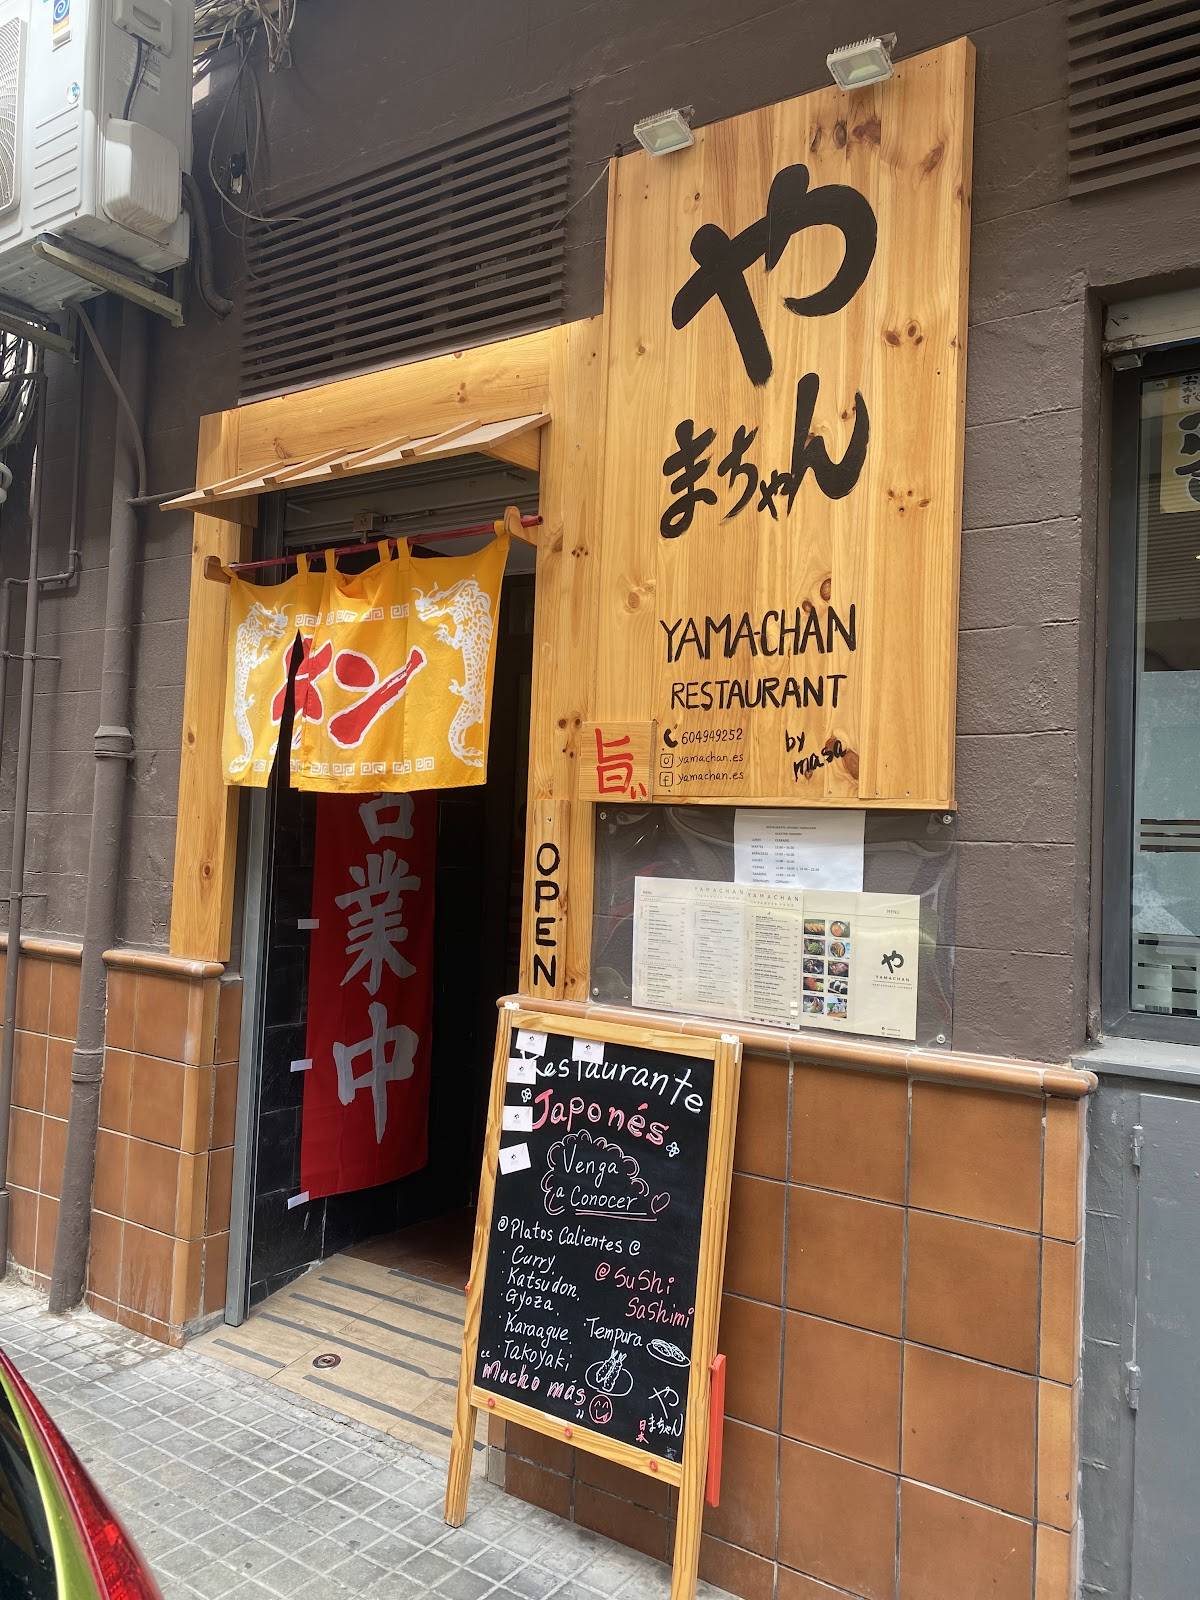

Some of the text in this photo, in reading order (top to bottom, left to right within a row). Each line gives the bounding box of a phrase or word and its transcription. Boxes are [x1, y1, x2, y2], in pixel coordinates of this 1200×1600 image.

[672, 164, 877, 387] や
[671, 674, 847, 710] RESTAURANT
[681, 728, 743, 744] 604949252
[785, 730, 806, 752] by
[676, 751, 744, 767] yamachan.es
[793, 740, 847, 782] masa
[676, 769, 744, 785] yamachan.es
[533, 843, 561, 988] OPEN
[532, 1088, 669, 1146] Japonés
[563, 1143, 619, 1188] Venga
[570, 1185, 637, 1211] Conocer
[558, 1225, 623, 1254] Calientes
[504, 1339, 573, 1372] Takoyaki
[648, 1385, 680, 1420] や
